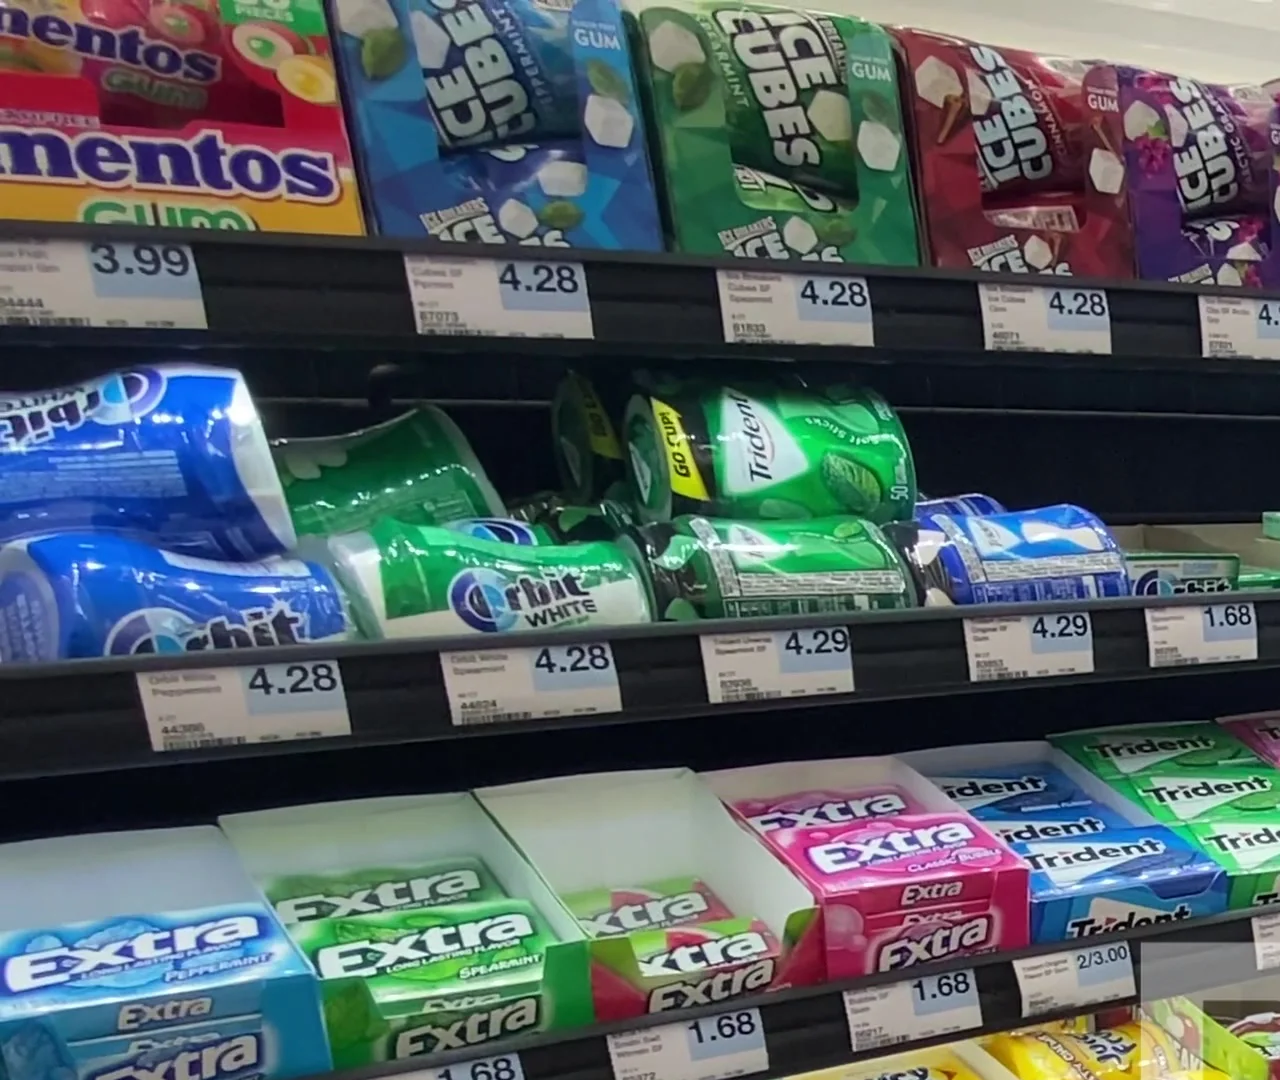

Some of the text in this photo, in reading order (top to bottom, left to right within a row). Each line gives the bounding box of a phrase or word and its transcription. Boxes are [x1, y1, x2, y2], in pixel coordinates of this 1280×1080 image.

[573, 29, 621, 50] GUM
[762, 11, 837, 89] ICE
[852, 61, 891, 82] GUM
[715, 11, 824, 165] CUBES
[970, 45, 1052, 183] ICE CUBES
[1087, 95, 1119, 113] GUM
[0, 134, 334, 197] mentos
[91, 244, 190, 276] 3.99
[500, 264, 578, 293] 4.28
[801, 280, 867, 307] 4.28
[1049, 292, 1106, 316] 4.28
[672, 451, 690, 477] GO
[448, 567, 592, 633] Orbit
[523, 600, 598, 630] WHITE
[1032, 615, 1088, 638] 4.29
[1205, 604, 1252, 627] 1.68
[785, 629, 849, 655] 4.29
[535, 645, 610, 673] 4.28
[249, 664, 337, 695] 4.28
[808, 823, 976, 874] Extra
[1028, 836, 1163, 869] Trident
[907, 856, 957, 874] CLASSIC
[901, 882, 964, 906] Extra
[5, 914, 260, 994] Extra
[317, 912, 535, 980] Extra
[1076, 946, 1127, 972] 2/3.00
[165, 952, 273, 985] PEPPERMINT
[459, 953, 542, 980] SPEARMINT
[912, 973, 970, 1002] 1.68
[117, 996, 212, 1032] Extra
[689, 1012, 755, 1043] 1.68
